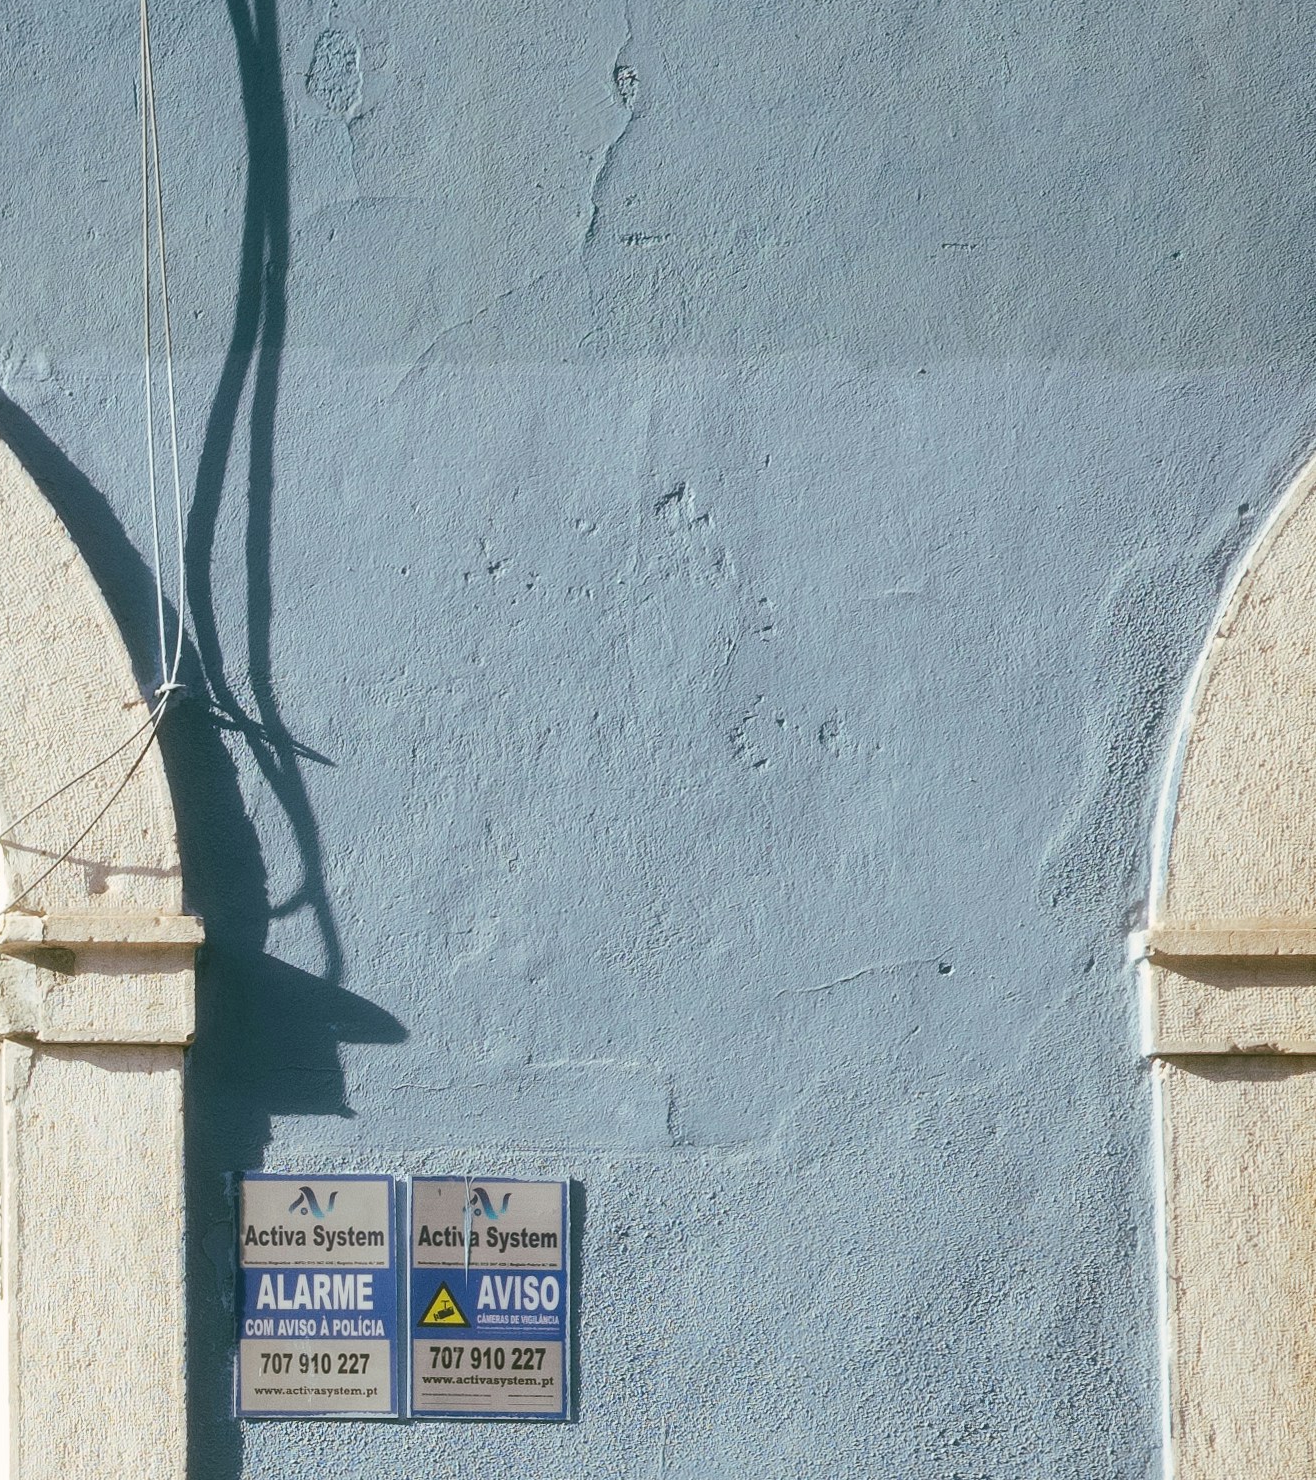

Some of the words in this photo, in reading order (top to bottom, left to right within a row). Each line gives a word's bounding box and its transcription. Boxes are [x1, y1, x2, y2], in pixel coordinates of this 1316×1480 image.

[244, 1225, 306, 1246] Activa
[313, 1225, 384, 1252] System
[418, 1225, 479, 1247] Activa
[486, 1226, 558, 1253] System
[256, 1274, 374, 1310] ALARME
[477, 1275, 559, 1311] AVISO
[245, 1319, 274, 1336] COM
[277, 1319, 316, 1336] AVISO
[320, 1316, 329, 1336] À
[333, 1315, 385, 1336] POLÍCIA
[477, 1313, 509, 1325] CÂMERAS
[510, 1315, 520, 1325] DE
[521, 1313, 560, 1325] VIGILÂNCIA
[261, 1353, 293, 1374] 707
[299, 1353, 331, 1374] 910
[337, 1353, 370, 1374] 227
[429, 1346, 464, 1369] 707
[470, 1347, 505, 1370] 910
[511, 1348, 546, 1370] 227
[254, 1386, 378, 1398] www.activasystem.pt
[422, 1375, 554, 1388] www.activasystem.pt
